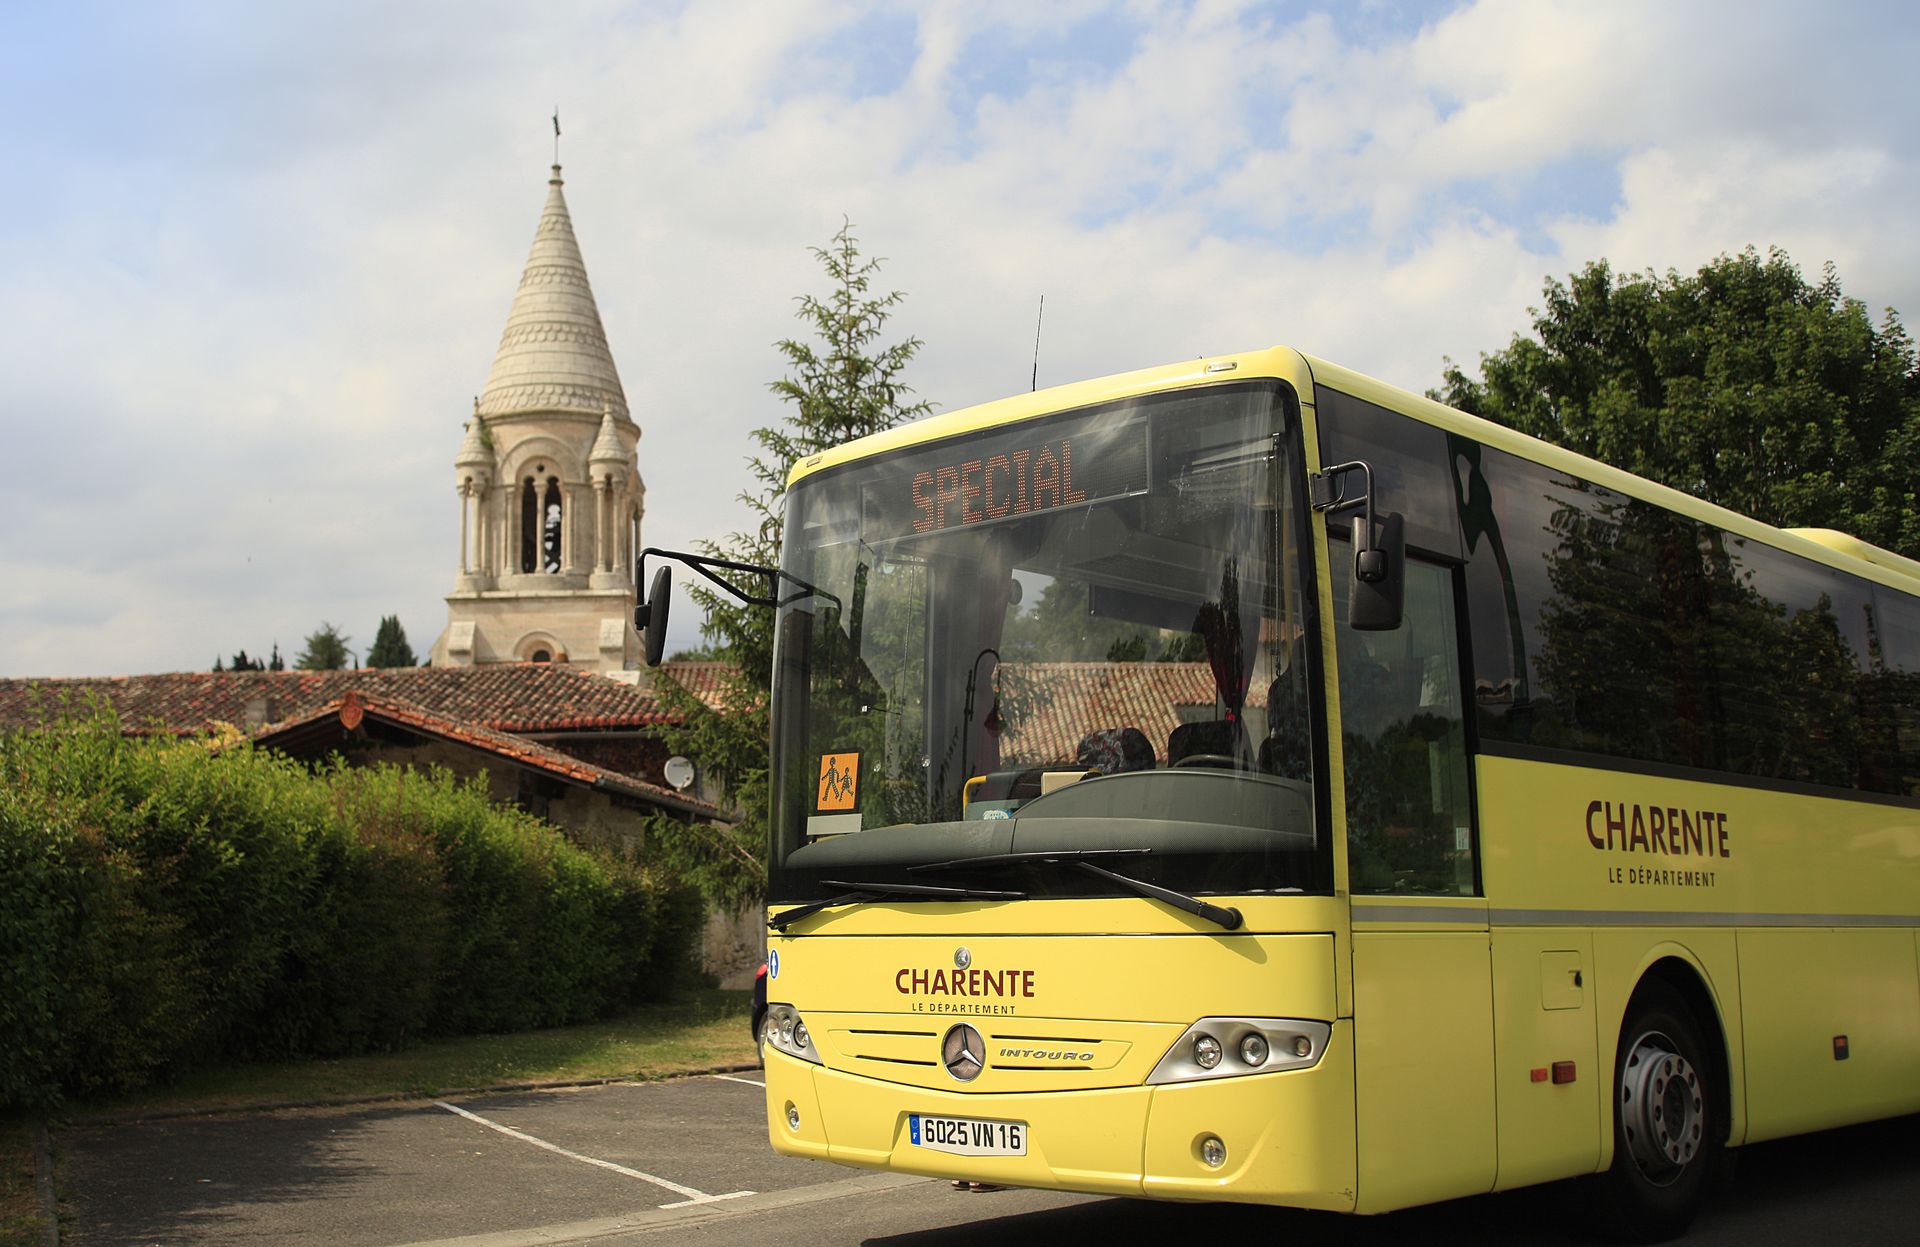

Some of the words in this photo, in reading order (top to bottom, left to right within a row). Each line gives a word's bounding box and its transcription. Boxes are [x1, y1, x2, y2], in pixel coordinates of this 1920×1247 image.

[912, 440, 1085, 533] SPECIAL
[1586, 800, 1730, 858] CHARENTE
[1609, 867, 1623, 884] LE
[1629, 865, 1716, 887] DÉPARTEMENT
[895, 968, 1035, 998] CHARENTE
[912, 1002, 924, 1012] LE
[929, 1001, 1016, 1015] DÉPARTEMENT
[1000, 1048, 1094, 1061] INTOURO
[925, 1119, 968, 1146] 6025
[972, 1122, 995, 1148] VN
[999, 1124, 1021, 1150] 16
